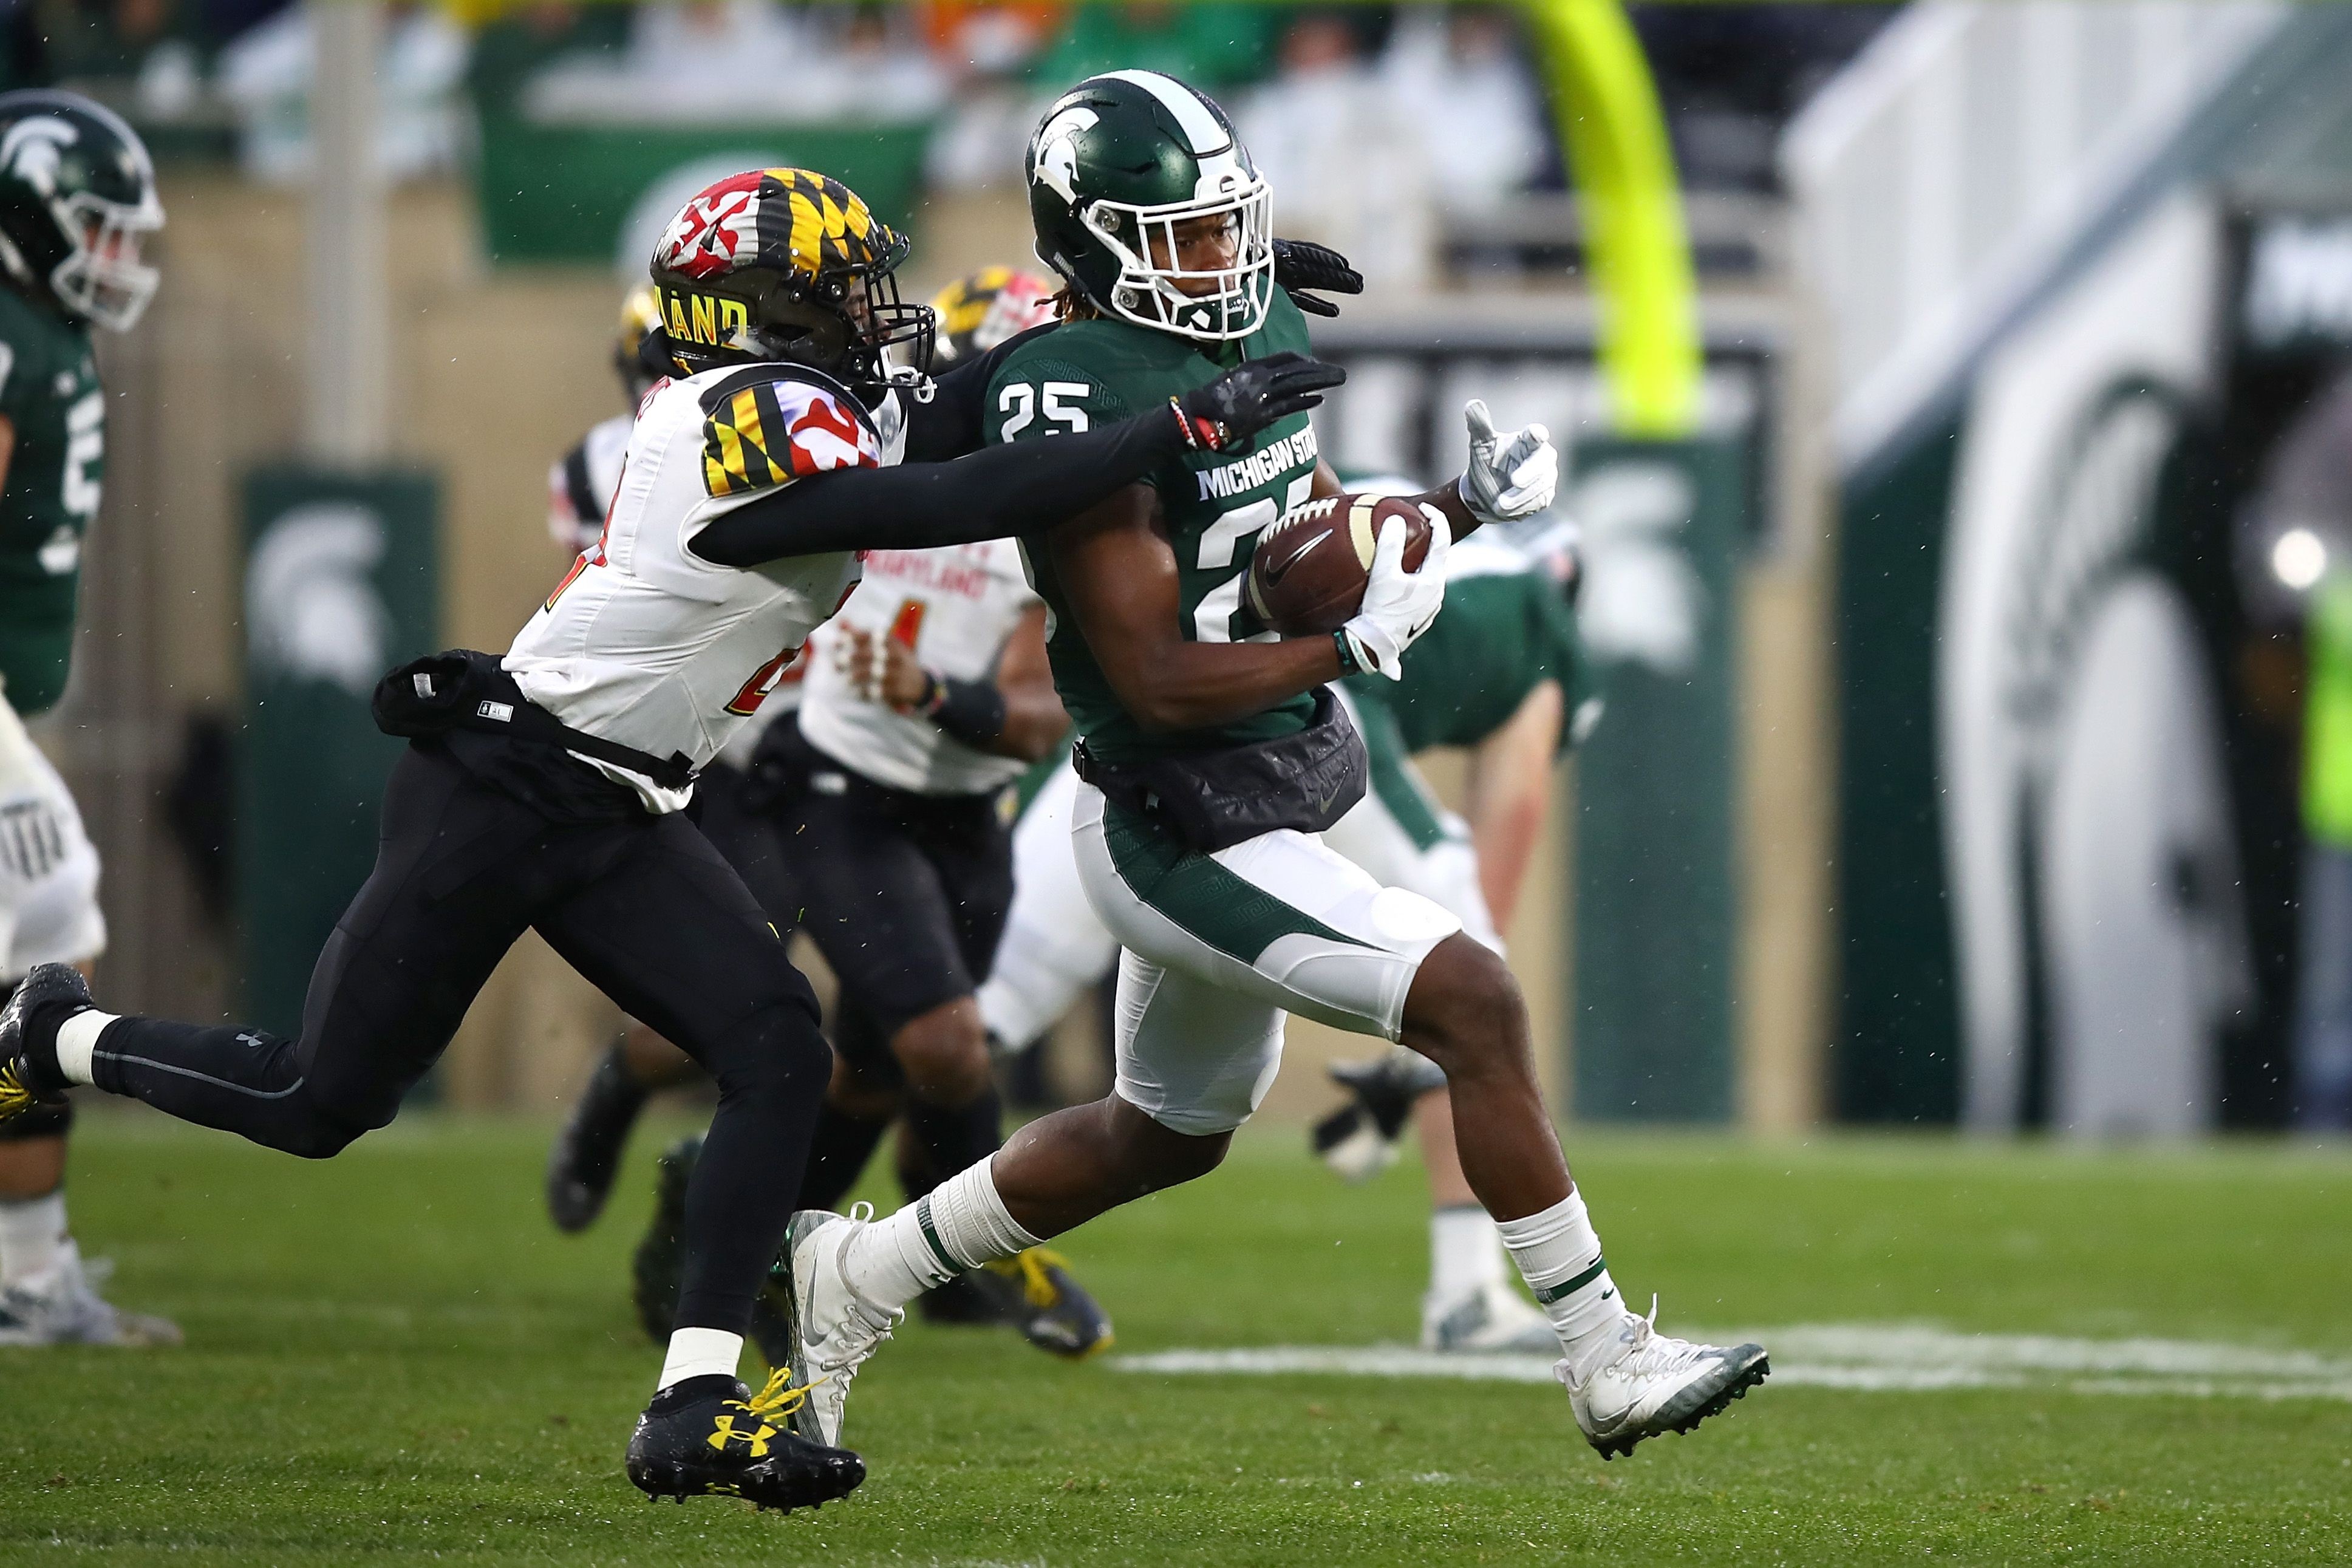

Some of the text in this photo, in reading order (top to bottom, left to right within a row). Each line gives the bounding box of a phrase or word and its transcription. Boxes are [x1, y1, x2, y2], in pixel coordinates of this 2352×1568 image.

[998, 381, 1090, 444] 25
[1195, 422, 1318, 502] MICHIGAN STA
